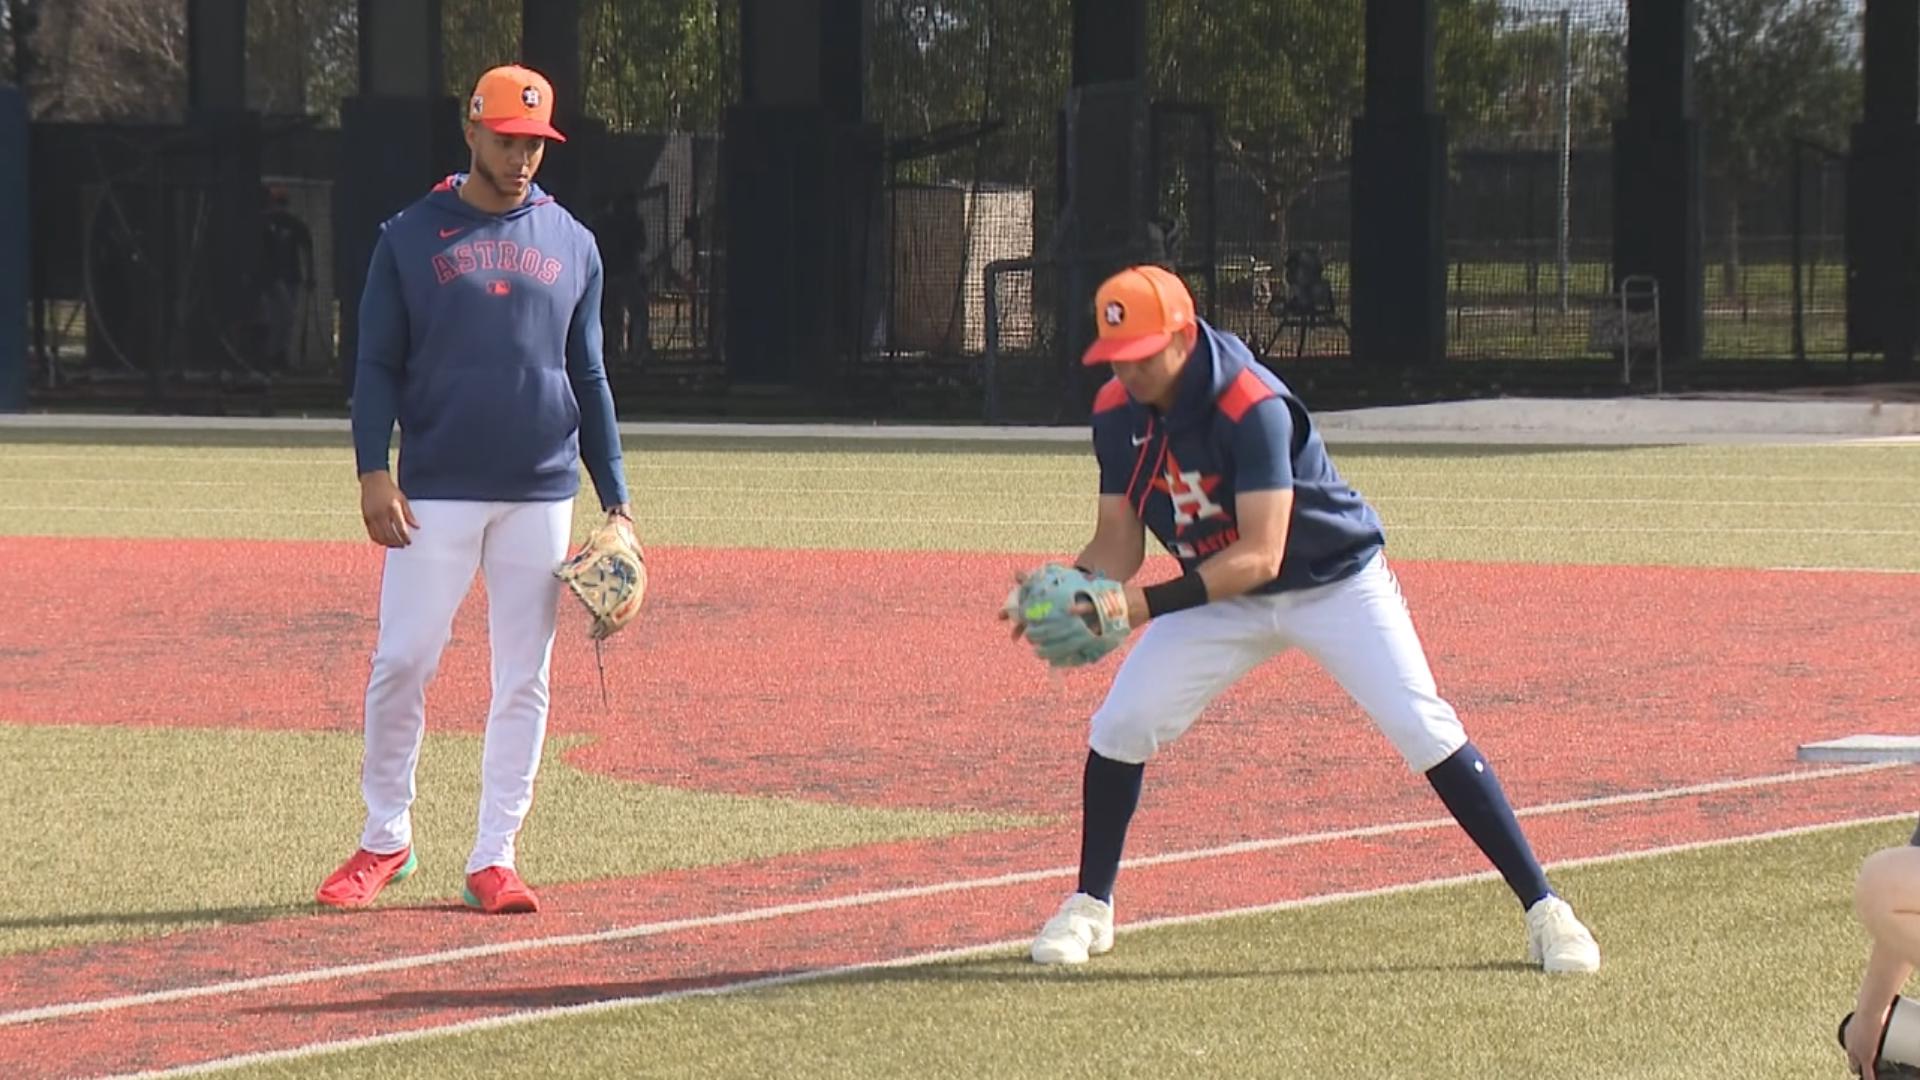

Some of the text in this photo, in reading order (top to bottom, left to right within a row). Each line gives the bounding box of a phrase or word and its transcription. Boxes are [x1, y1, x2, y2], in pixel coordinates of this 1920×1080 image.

[432, 240, 563, 285] ASTROS
[1163, 469, 1223, 525] H
[1194, 528, 1239, 556] ASTR
